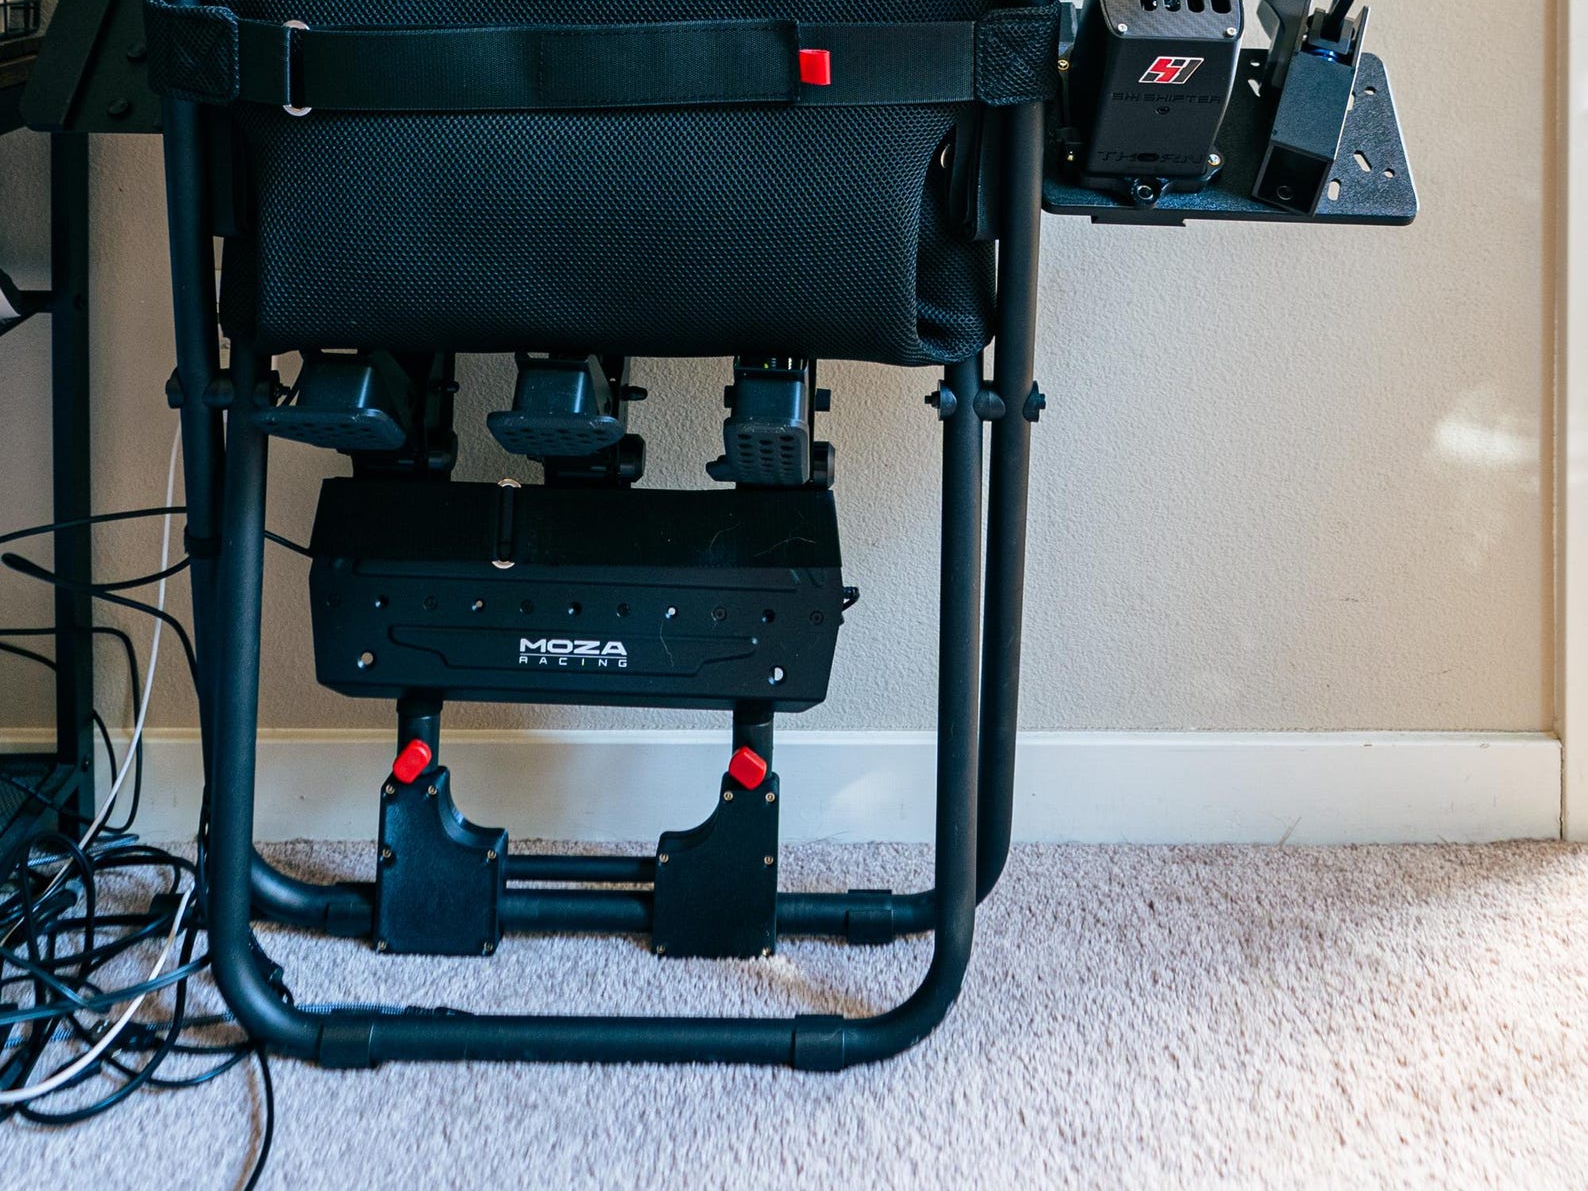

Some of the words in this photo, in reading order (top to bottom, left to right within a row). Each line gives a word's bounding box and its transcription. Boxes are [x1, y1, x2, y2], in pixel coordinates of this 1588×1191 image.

[1143, 93, 1222, 104] SHIFTER
[519, 638, 628, 656] MOZA
[519, 656, 628, 668] RACING
